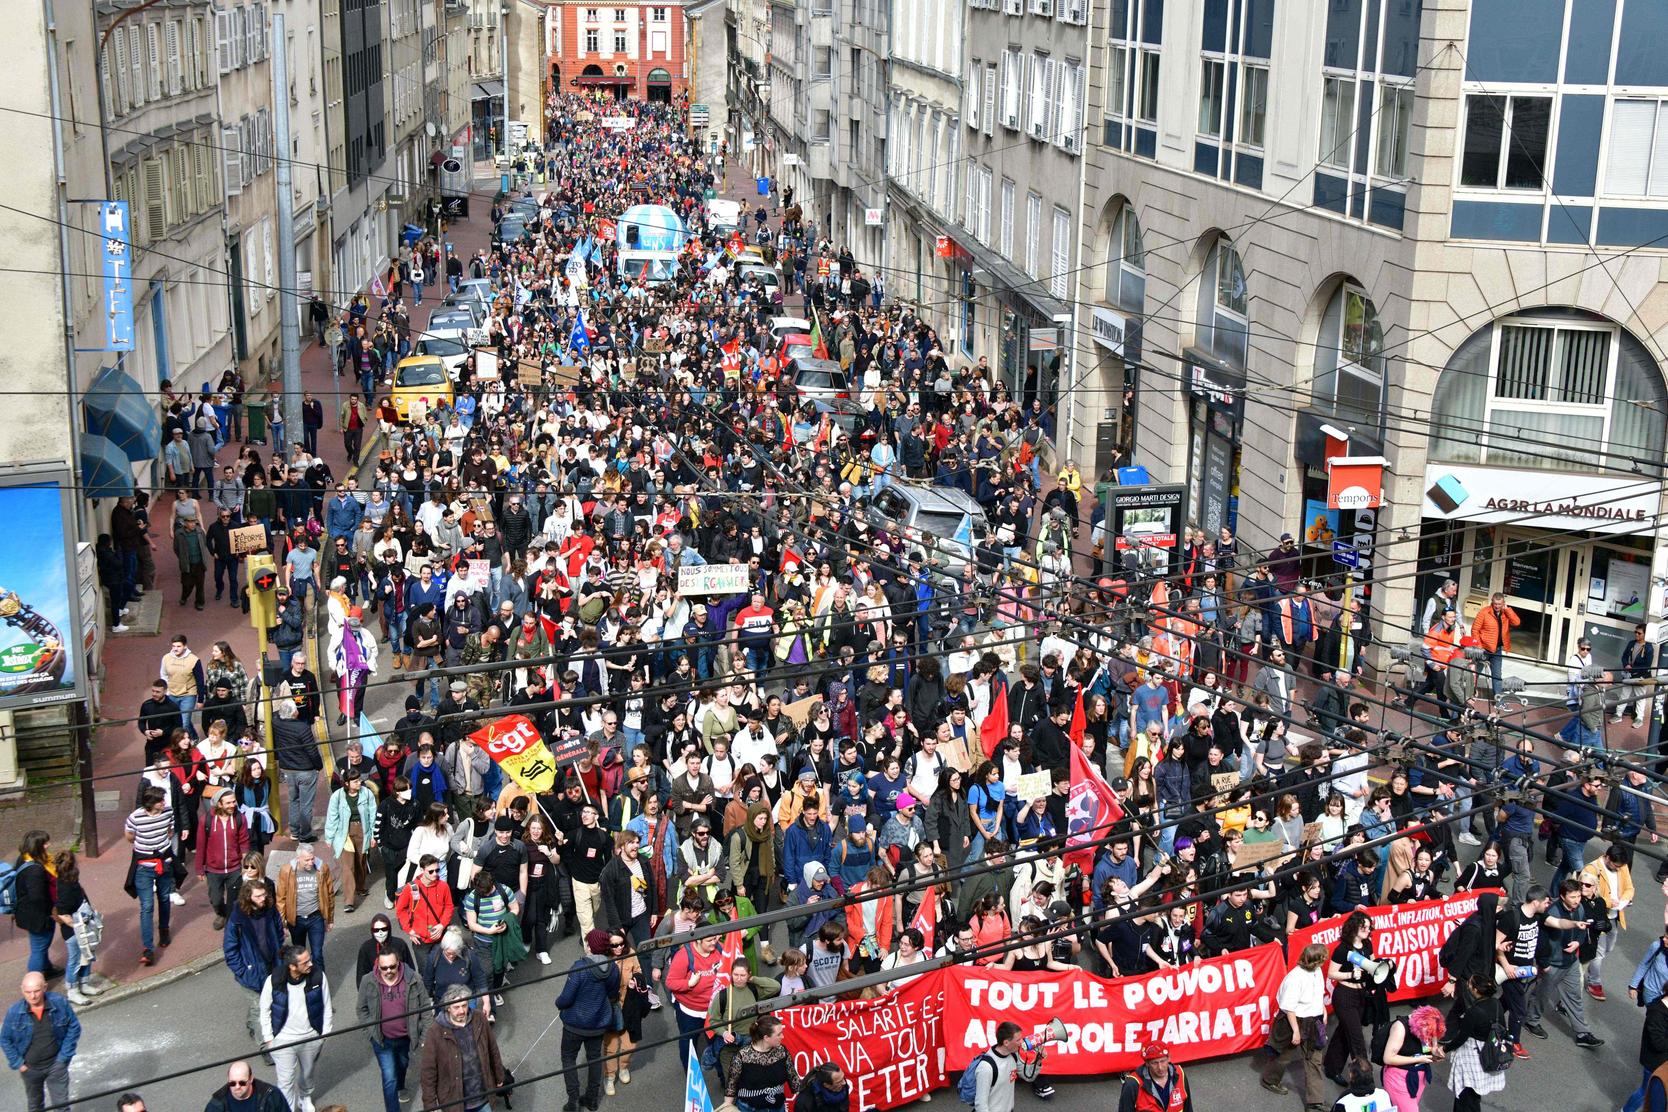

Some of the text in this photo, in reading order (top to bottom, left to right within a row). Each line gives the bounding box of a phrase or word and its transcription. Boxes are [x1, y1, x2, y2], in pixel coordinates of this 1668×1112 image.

[1115, 496, 1140, 504] GIORGIO
[1159, 493, 1180, 501] DESIGN
[1331, 493, 1378, 506] Temporis
[1485, 497, 1646, 521] AG2R LA MONDIALE
[680, 567, 701, 576] NOUS
[730, 564, 748, 573] TOUS
[680, 578, 696, 588] DES
[32, 693, 77, 703] summum
[488, 722, 534, 753] cgt
[1371, 913, 1397, 929] IMAT,
[1398, 906, 1443, 926] INFLATION,
[1311, 925, 1343, 945] RETRA
[1378, 923, 1440, 955] RAISON
[813, 955, 840, 967] SCOTT
[964, 959, 1256, 1011] TOUT LE POUVOIR
[794, 1017, 940, 1080] ON VA TOUT
